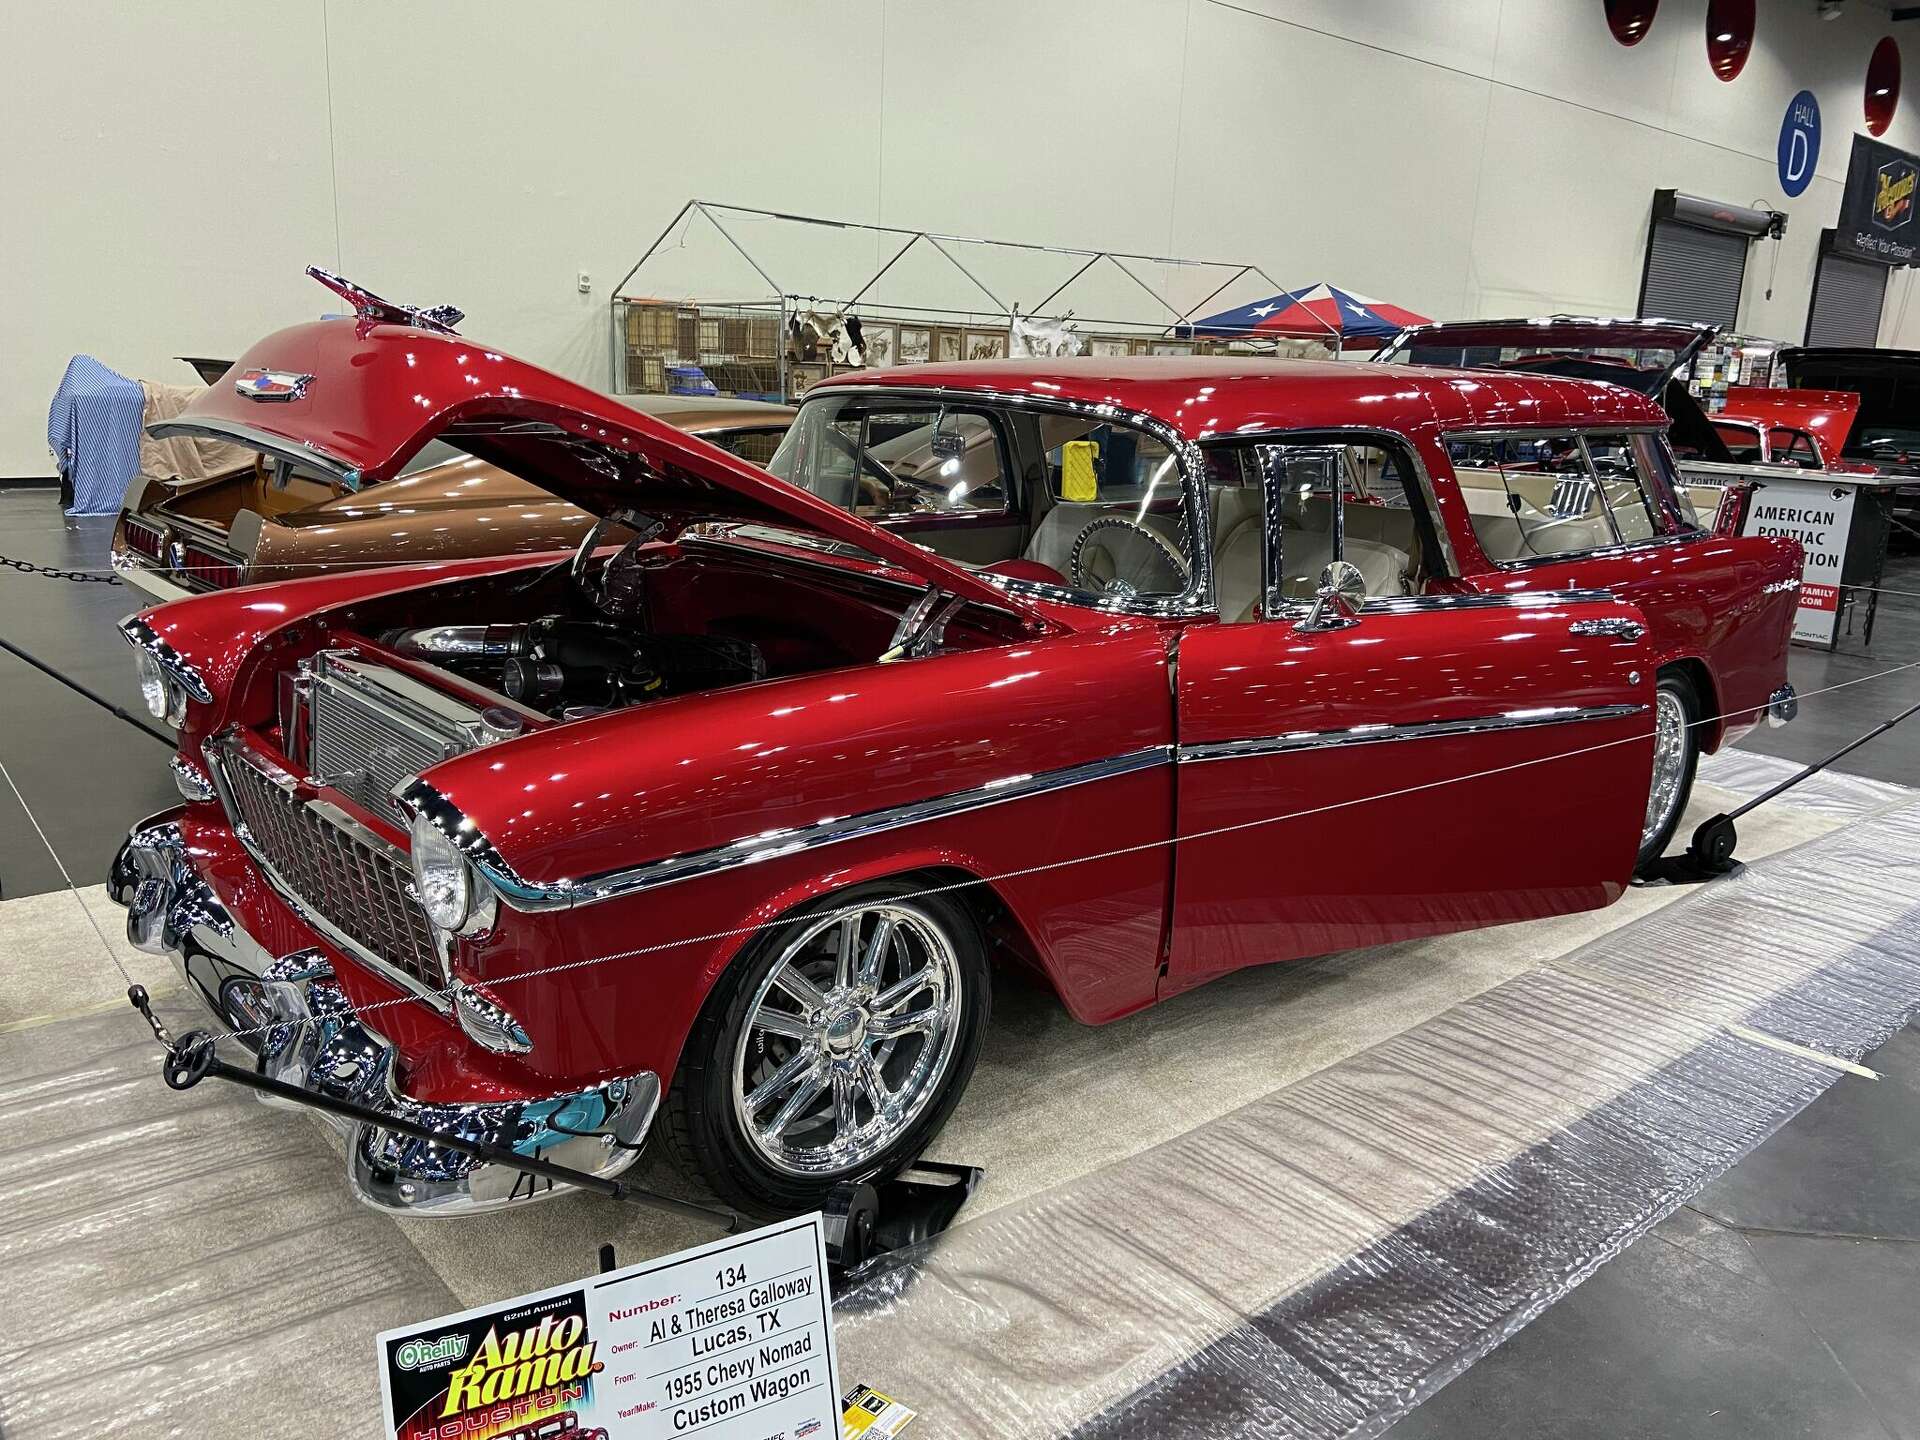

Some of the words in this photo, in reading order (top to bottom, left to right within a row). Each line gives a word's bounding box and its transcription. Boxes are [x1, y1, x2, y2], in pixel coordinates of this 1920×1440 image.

[1794, 103, 1814, 128] HALL
[1786, 129, 1808, 182] D
[1754, 506, 1835, 526] AMERICAN
[1758, 527, 1825, 546] PONTIAC
[504, 1309, 532, 1322] 62nd
[533, 1298, 572, 1314] Annual
[609, 1294, 682, 1322] Number:
[715, 1263, 747, 1290] 134
[611, 1340, 639, 1354] Owner:
[650, 1318, 666, 1343] Al
[671, 1314, 682, 1335] &
[686, 1298, 745, 1329] Theresa
[749, 1275, 812, 1308] Galloway
[399, 1337, 467, 1368] O'Reilly
[459, 1312, 584, 1378] Auto
[692, 1325, 752, 1357] Lucas,
[757, 1308, 781, 1333] TX
[420, 1364, 434, 1373] AUTO
[433, 1360, 451, 1369] PARTS
[438, 1341, 598, 1419] Rama
[614, 1372, 637, 1386] From:
[617, 1400, 658, 1419] Year/Make:
[664, 1370, 702, 1401] 1955
[707, 1356, 756, 1386] Chevy
[759, 1332, 812, 1363] Nomad
[414, 1386, 583, 1440] HOUSTON
[673, 1391, 746, 1431] Custom
[750, 1368, 810, 1403] Wagon
